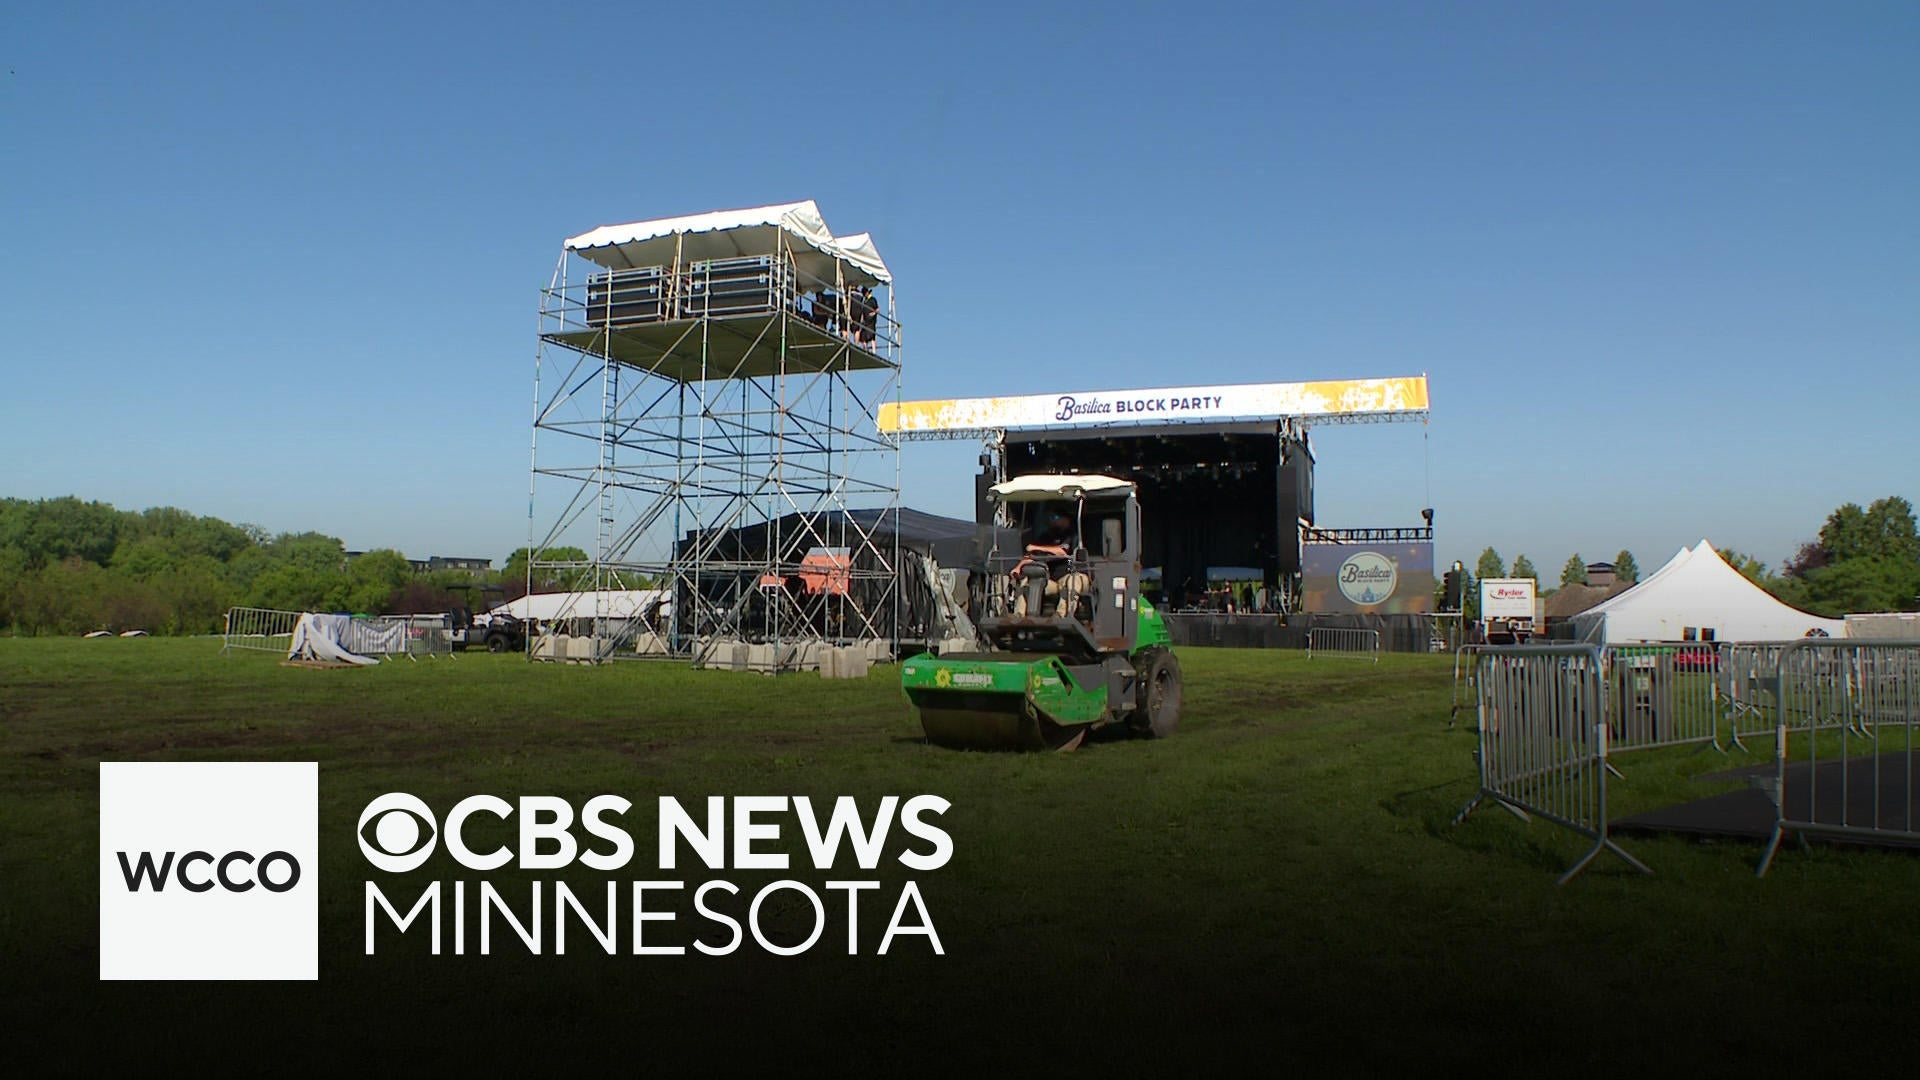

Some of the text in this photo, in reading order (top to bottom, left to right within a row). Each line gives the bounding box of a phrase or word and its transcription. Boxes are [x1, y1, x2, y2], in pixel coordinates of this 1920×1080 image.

[1056, 396, 1222, 421] Basilica BLOCK PARTY
[1341, 563, 1391, 583] Basilica
[1497, 588, 1524, 600] Ryder
